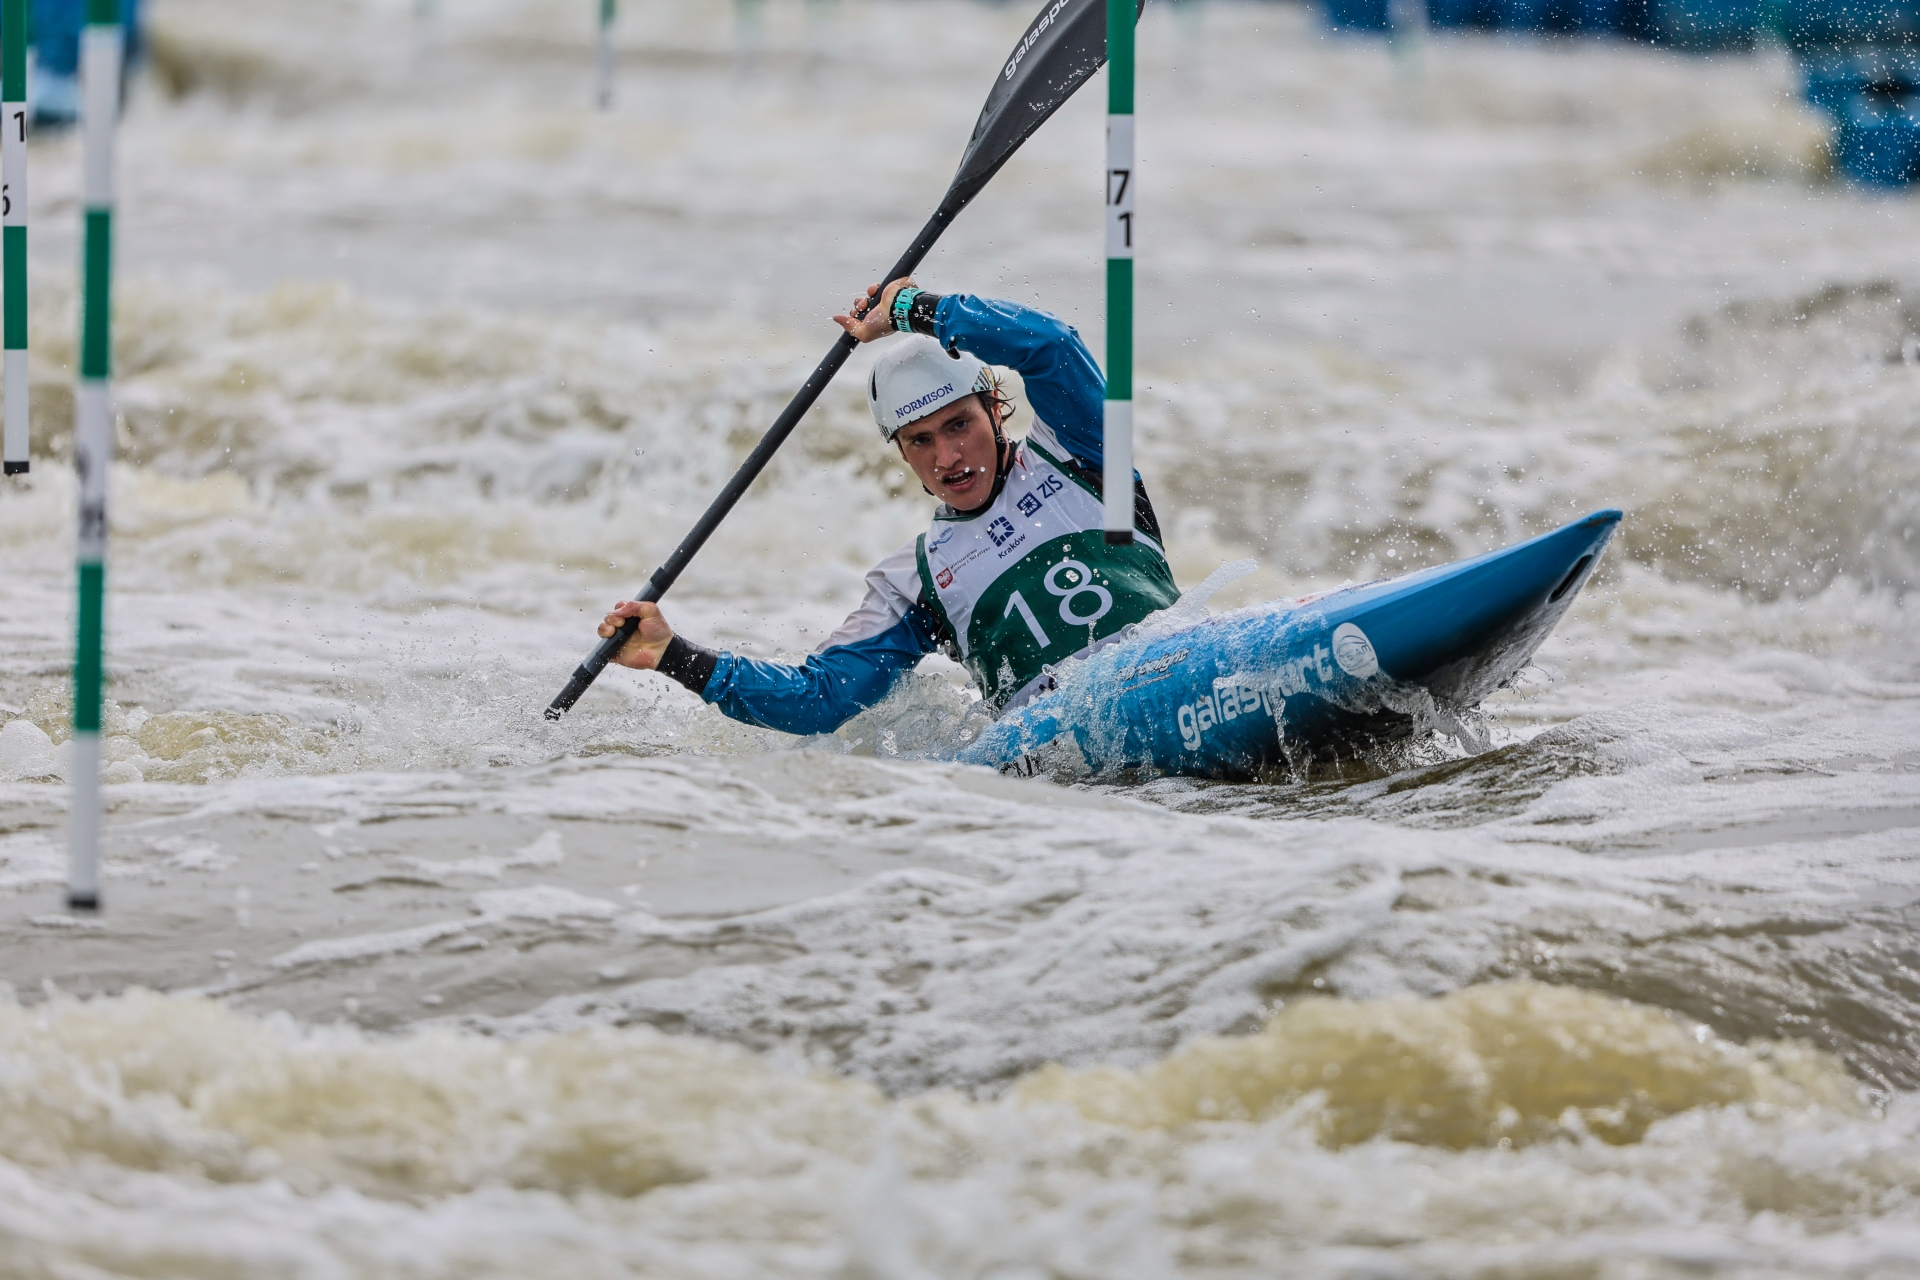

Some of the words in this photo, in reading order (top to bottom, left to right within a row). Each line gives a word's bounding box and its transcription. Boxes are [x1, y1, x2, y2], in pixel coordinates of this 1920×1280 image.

[895, 383, 954, 419] NORMISON
[1036, 474, 1063, 499] ZIS
[998, 533, 1026, 559] Kraków
[1003, 560, 1113, 649] 18
